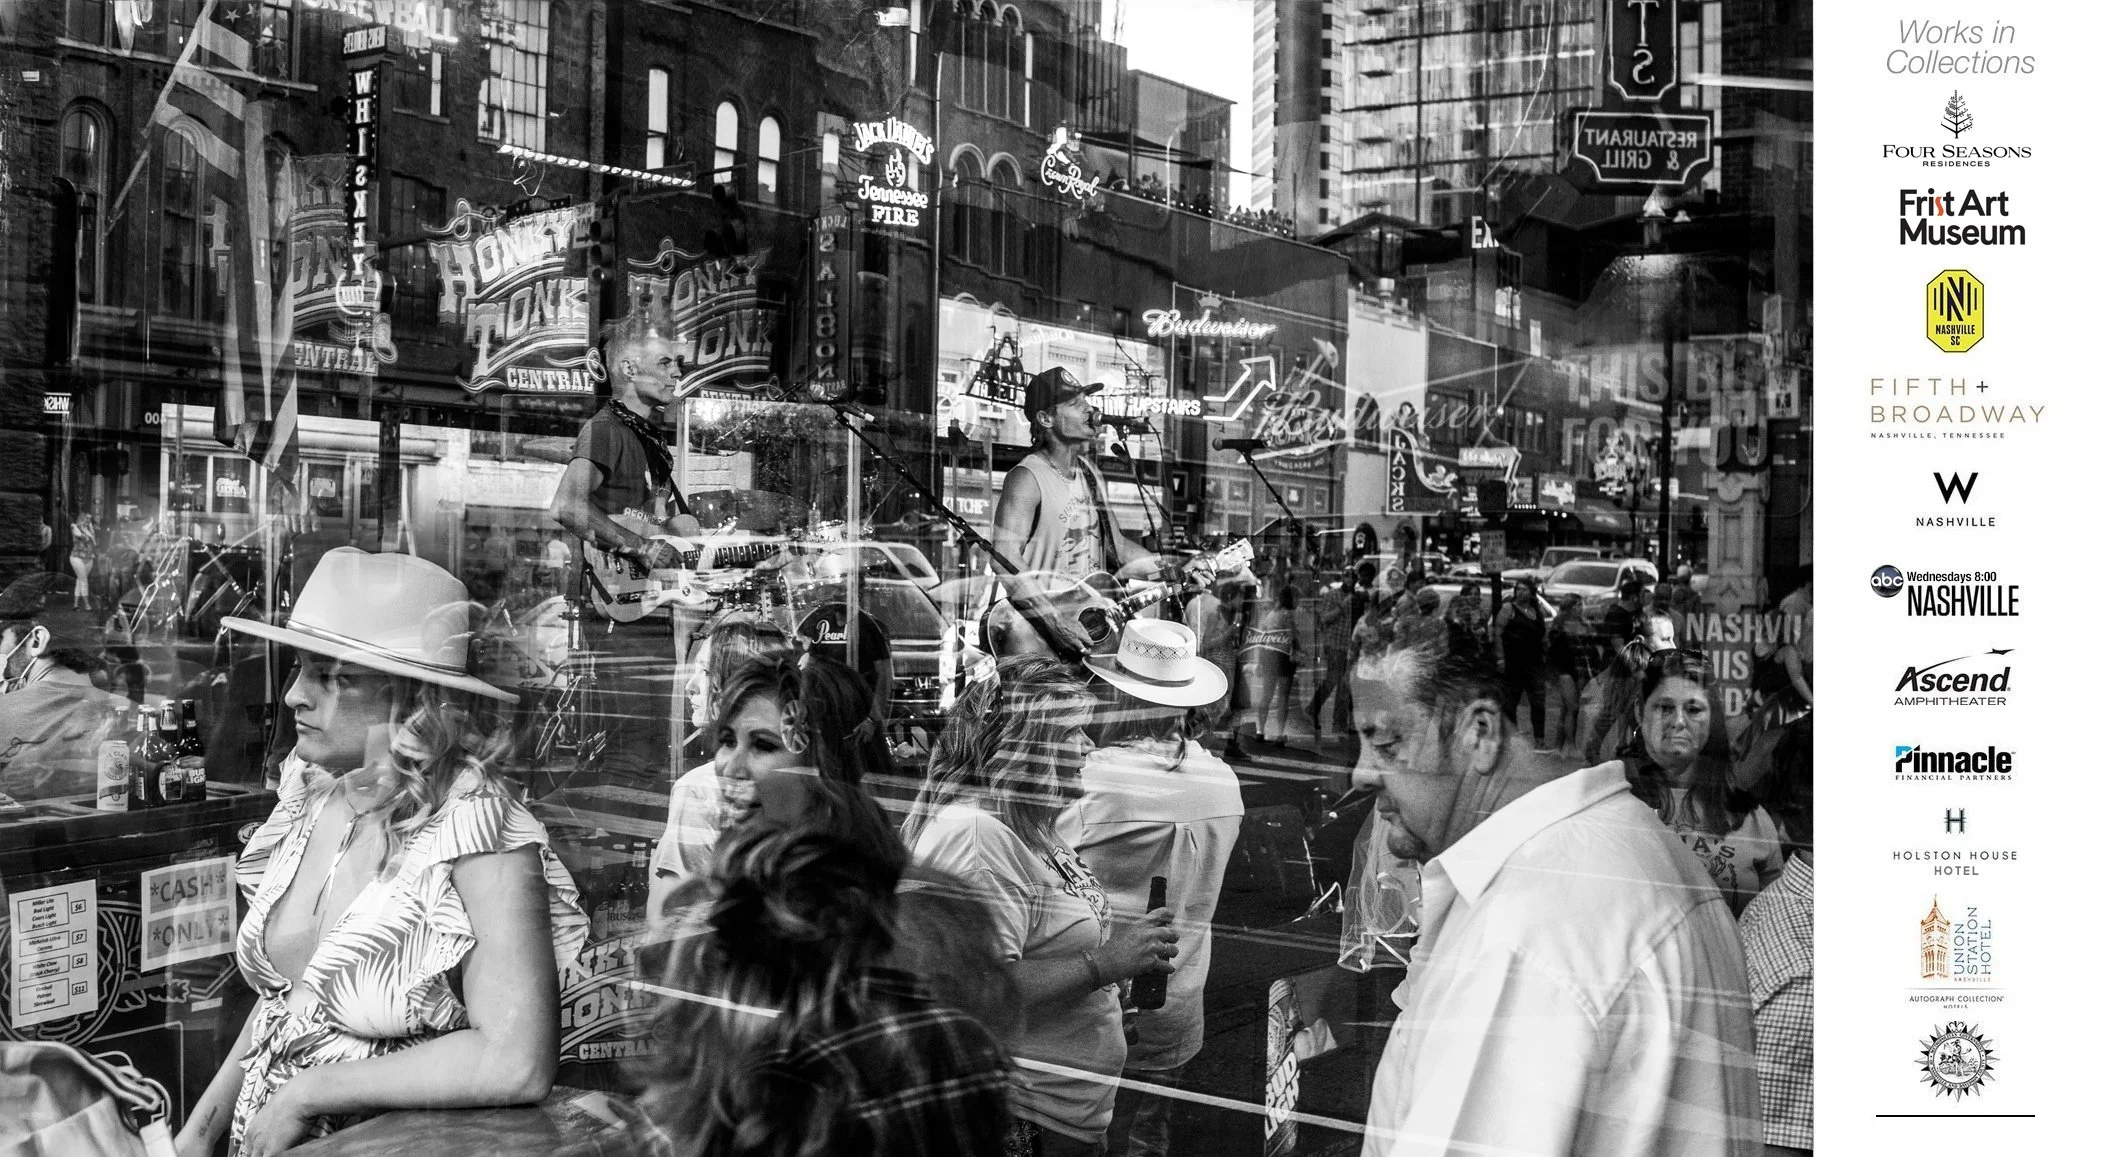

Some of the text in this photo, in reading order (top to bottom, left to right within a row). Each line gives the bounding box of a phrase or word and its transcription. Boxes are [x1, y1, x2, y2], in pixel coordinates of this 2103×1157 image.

[857, 174, 929, 208] Tennessee
[871, 204, 919, 226] FIRE
[428, 206, 576, 325] HONKY
[465, 278, 590, 385] TONK
[1142, 308, 1279, 340] Budweiser
[506, 366, 595, 393] CENTRAL
[1132, 397, 1201, 416] UPSTAIRS
[811, 619, 848, 644] Pearl
